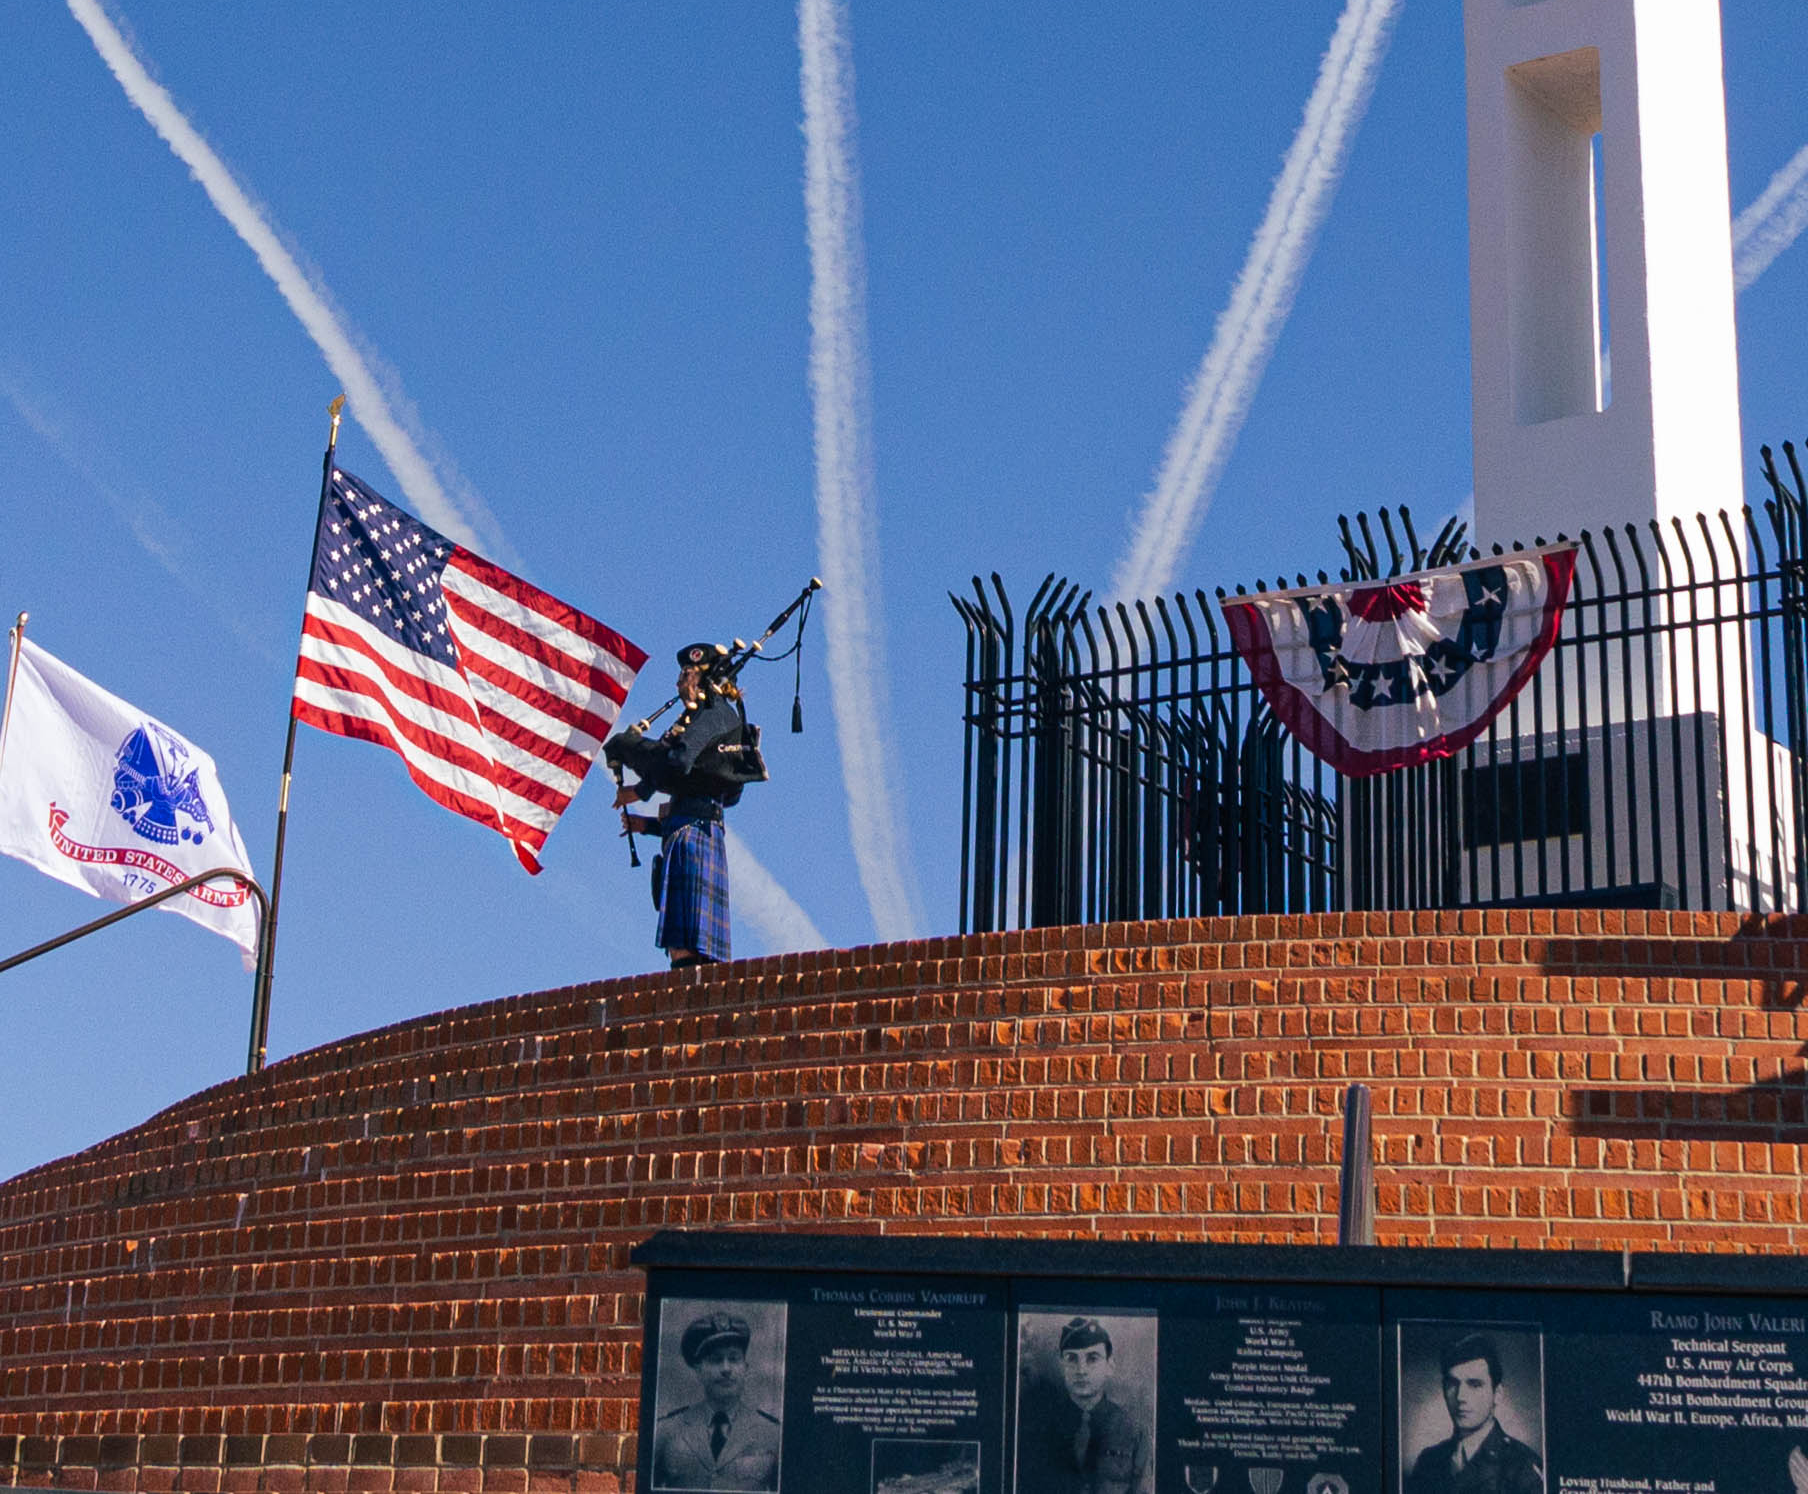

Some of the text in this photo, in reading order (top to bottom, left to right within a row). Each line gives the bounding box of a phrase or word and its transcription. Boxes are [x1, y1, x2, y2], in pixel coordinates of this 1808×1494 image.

[53, 829, 242, 905] UNITED STATES ARMY
[123, 873, 157, 895] 1775
[810, 1288, 865, 1302] THOMAS
[897, 1309, 942, 1318] Commander
[898, 1320, 918, 1329] Navy
[1651, 1310, 1806, 1332] RAMO JOHN VALERI
[873, 1329, 896, 1338] World
[898, 1330, 914, 1338] War
[1268, 1328, 1289, 1337] Army
[1245, 1337, 1268, 1346] World
[1270, 1338, 1286, 1346] War
[1671, 1338, 1787, 1356] Technical Sergeant
[869, 1350, 889, 1358] Good
[926, 1351, 962, 1359] American
[1264, 1348, 1303, 1358] Campaign
[951, 1359, 973, 1368] World
[1232, 1362, 1308, 1372] Purple Heart Medal
[1665, 1356, 1794, 1375] U. S. Army Air Corps
[892, 1367, 910, 1376] Navy
[1209, 1372, 1231, 1381] Army
[1299, 1375, 1331, 1384] Citation
[1637, 1373, 1673, 1387] 447th
[1675, 1374, 1761, 1390] Bombardment
[1224, 1384, 1316, 1395] Combat Infantry Badge
[1649, 1392, 1683, 1405] 321st
[1686, 1393, 1771, 1409] Bombardment
[1605, 1409, 1642, 1422] World
[1645, 1410, 1671, 1423] War
[1741, 1412, 1783, 1427] Africa,
[1559, 1476, 1715, 1492] Loving Husband, Father and
